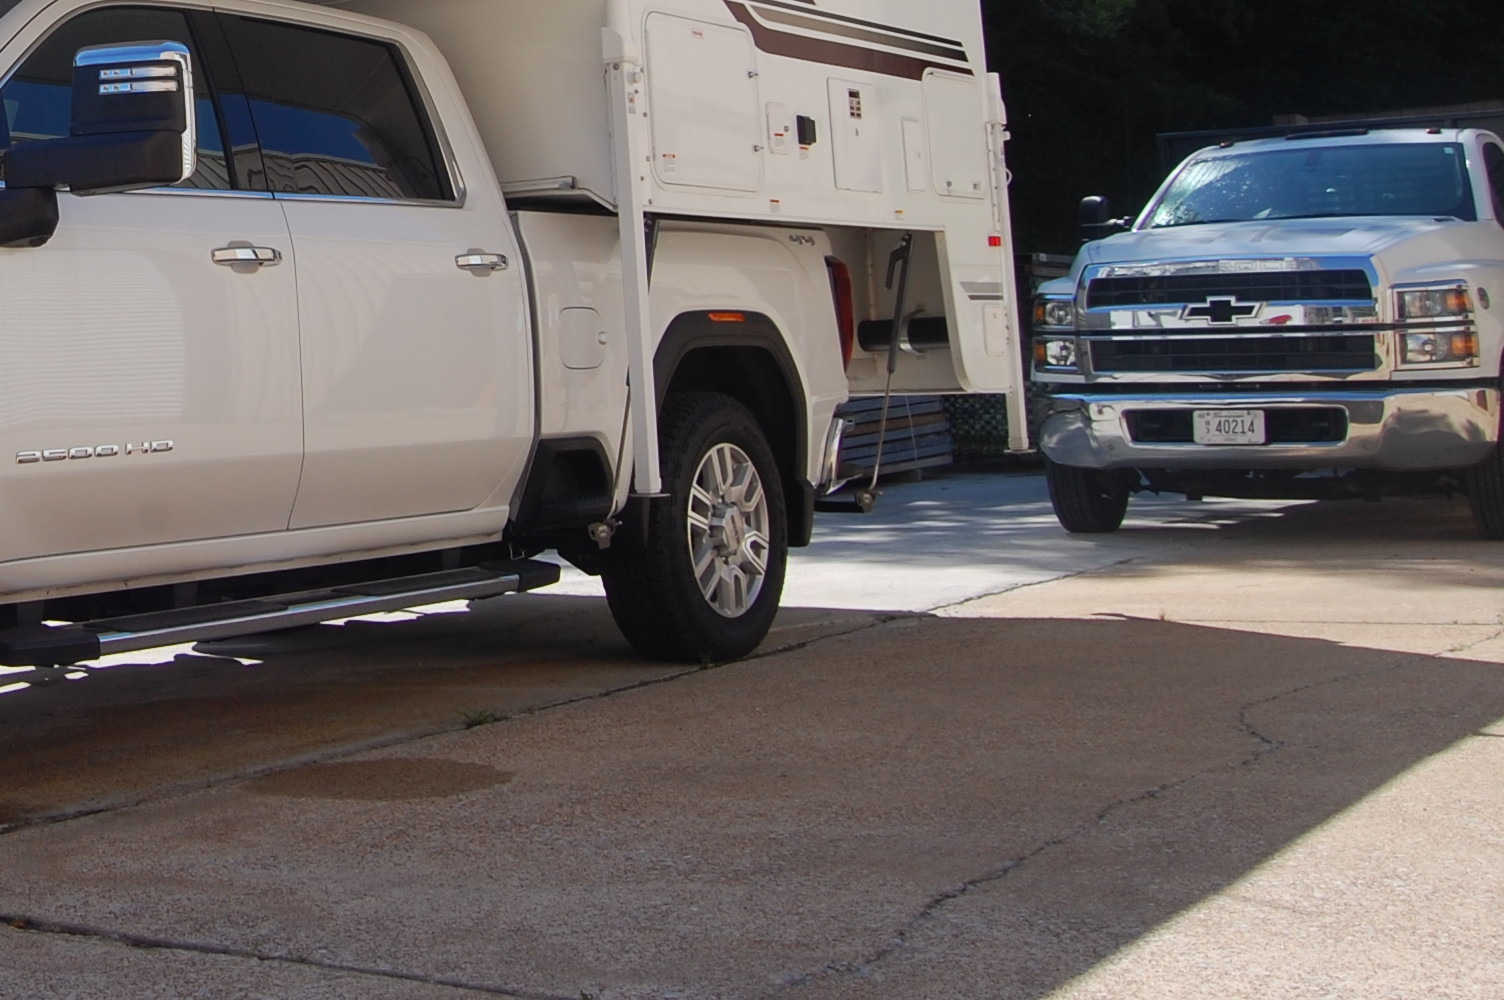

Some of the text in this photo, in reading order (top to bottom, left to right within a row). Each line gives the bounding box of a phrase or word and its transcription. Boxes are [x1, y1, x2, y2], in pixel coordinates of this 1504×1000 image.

[1215, 418, 1255, 434] 40214
[16, 439, 175, 464] 2500 HD
